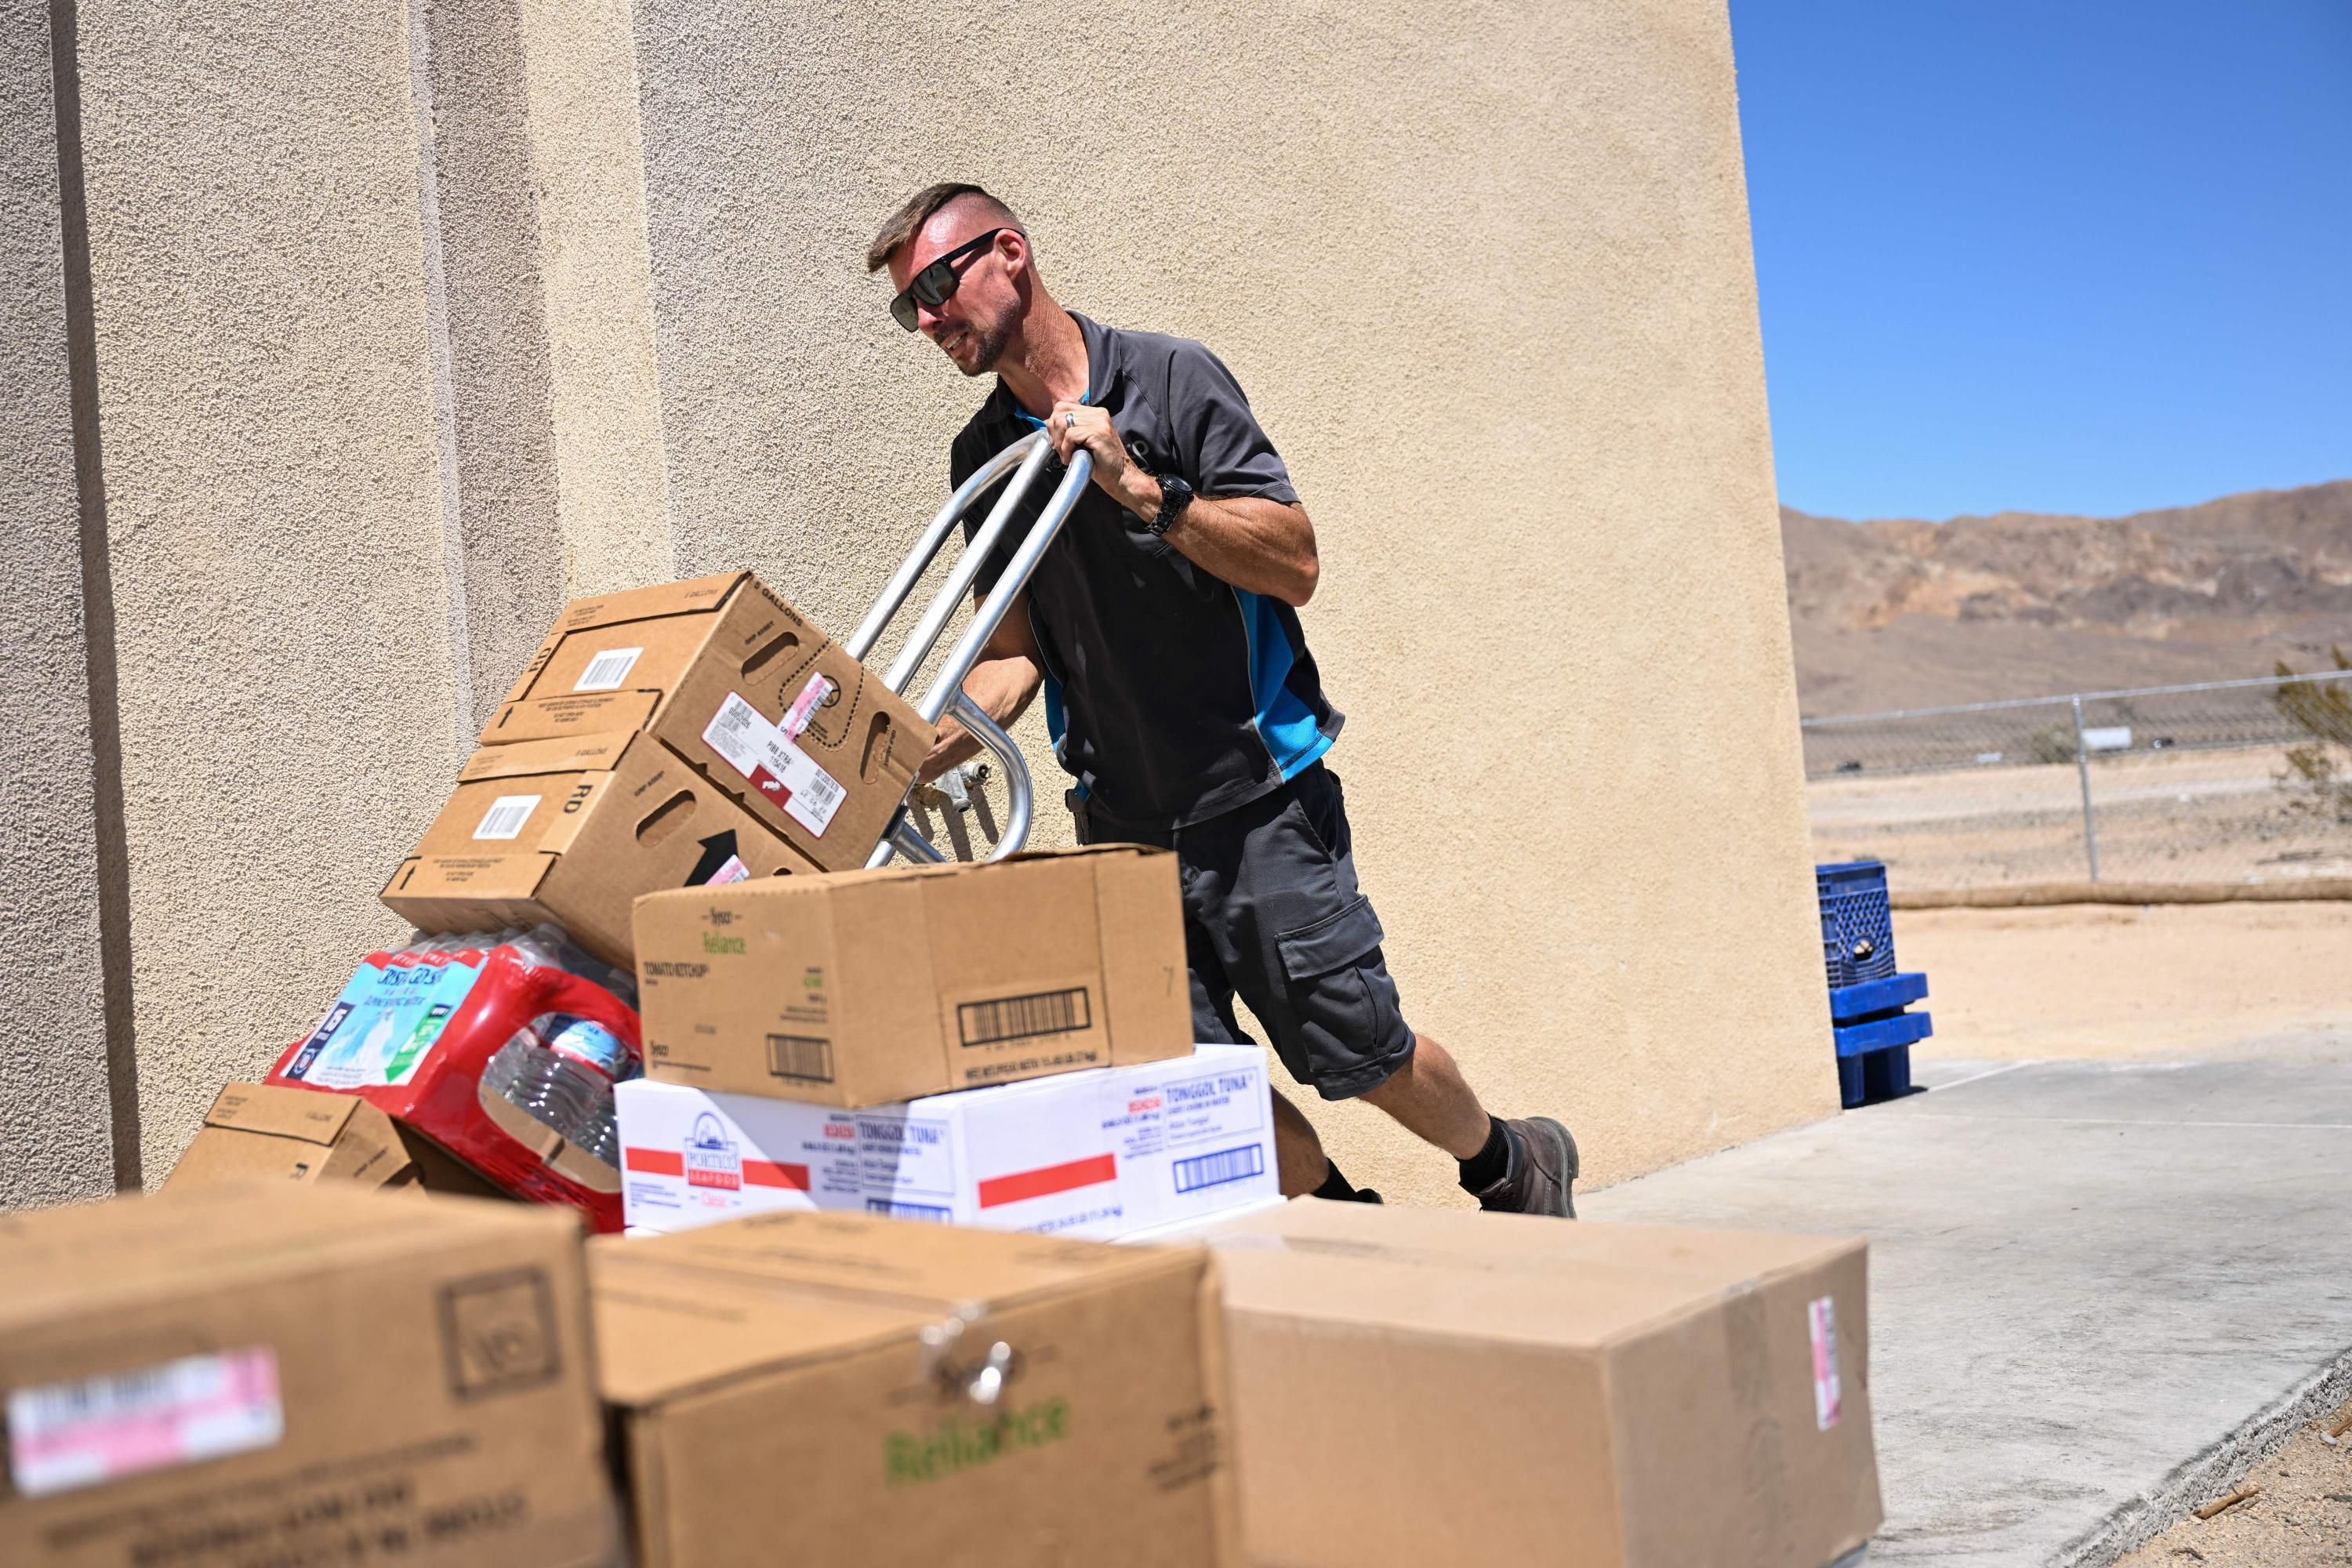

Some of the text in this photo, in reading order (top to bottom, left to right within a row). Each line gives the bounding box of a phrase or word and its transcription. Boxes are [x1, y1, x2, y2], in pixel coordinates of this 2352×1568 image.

[761, 588, 804, 626] GALLONS
[778, 749, 792, 766] XTRA
[563, 784, 593, 815] RD
[710, 907, 732, 926] Sysco
[702, 931, 746, 954] Reliance
[644, 962, 708, 978] TOMATO KETCHUP
[650, 1040, 669, 1057] Sysco
[1166, 1081, 1216, 1102] TONGGOL
[1219, 1076, 1247, 1093] TUNA
[859, 1122, 906, 1142] TONGGOL
[909, 1126, 939, 1144] TUNA
[688, 1152, 739, 1170] PORTICO
[690, 1171, 739, 1185] SEAFOOD
[884, 1396, 1071, 1488] Reliance
